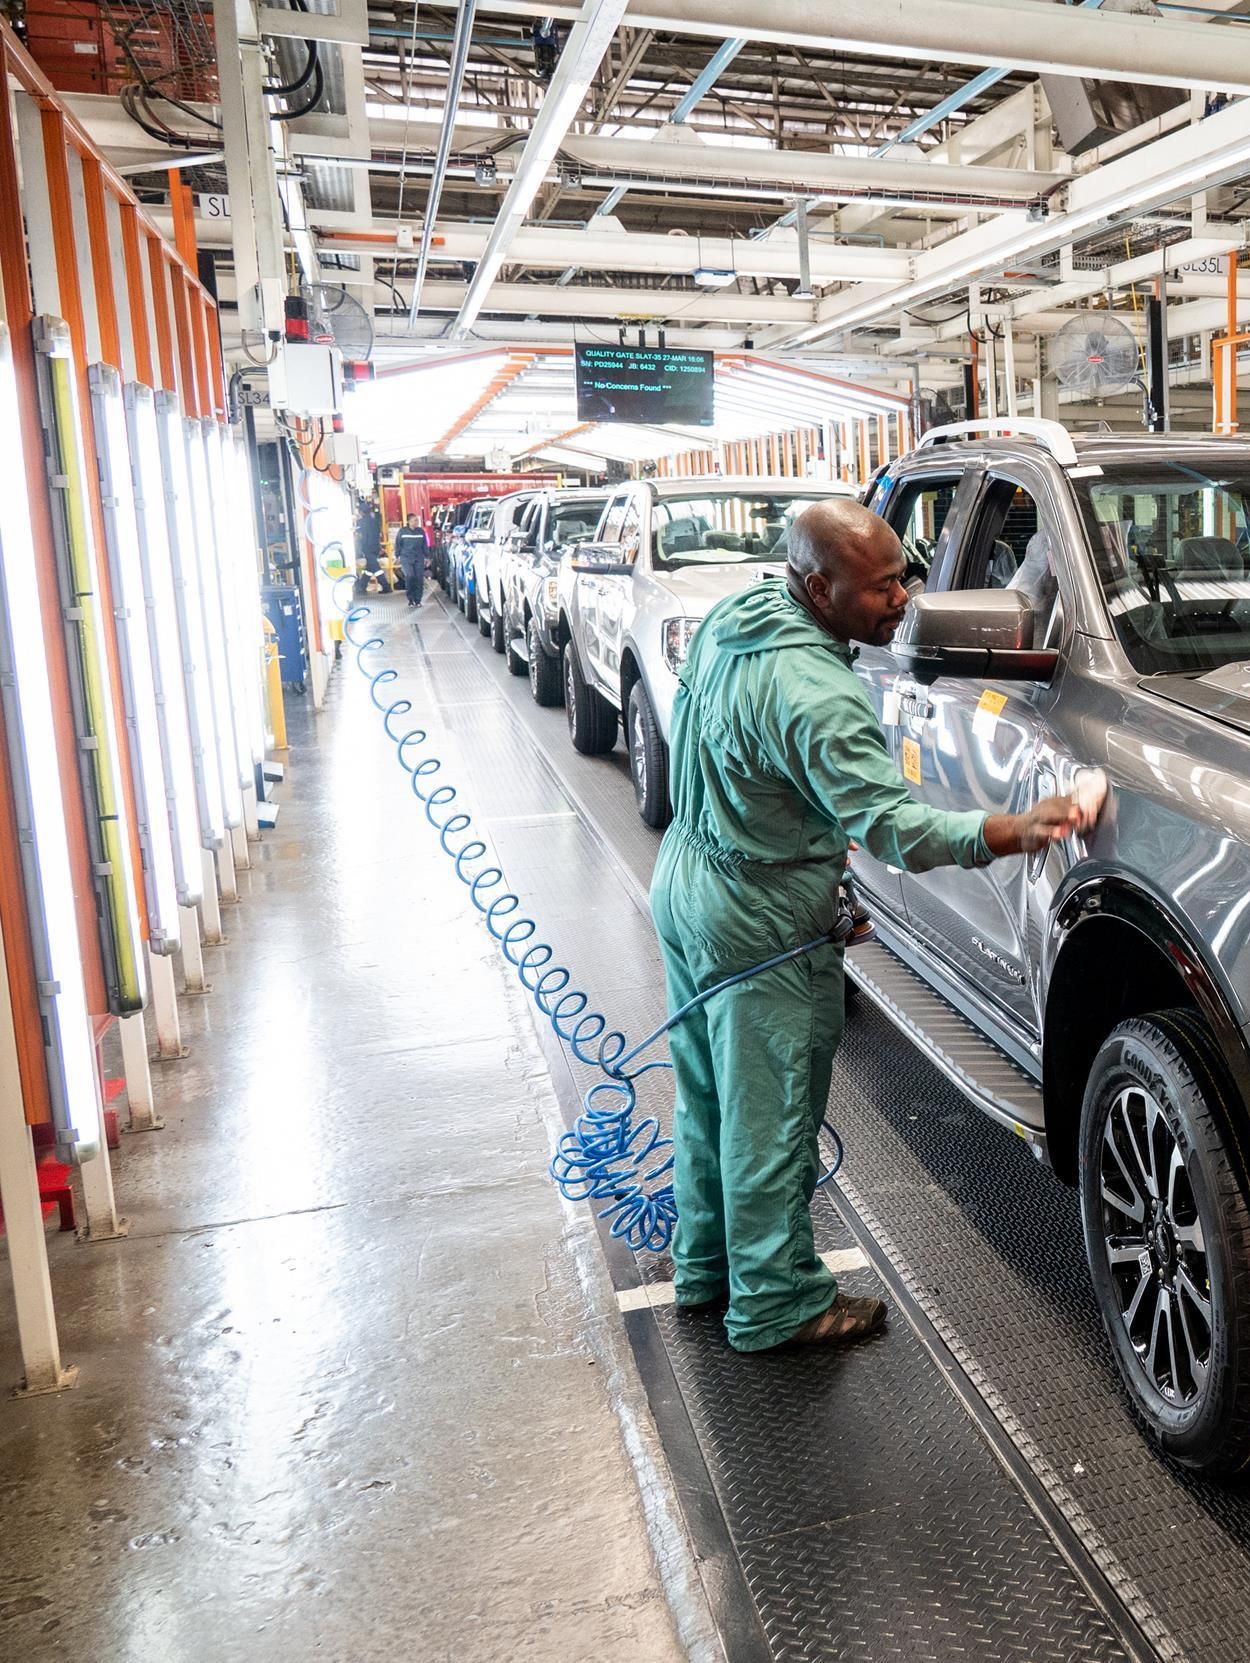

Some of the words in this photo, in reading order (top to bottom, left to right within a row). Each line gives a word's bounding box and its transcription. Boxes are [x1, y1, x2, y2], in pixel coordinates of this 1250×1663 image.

[208, 197, 231, 217] SL
[585, 350, 614, 358] QUALITY
[615, 352, 634, 360] GATE
[639, 363, 656, 371] 6432
[594, 381, 605, 389] No
[606, 382, 639, 391] Concerns
[640, 384, 661, 392] Found
